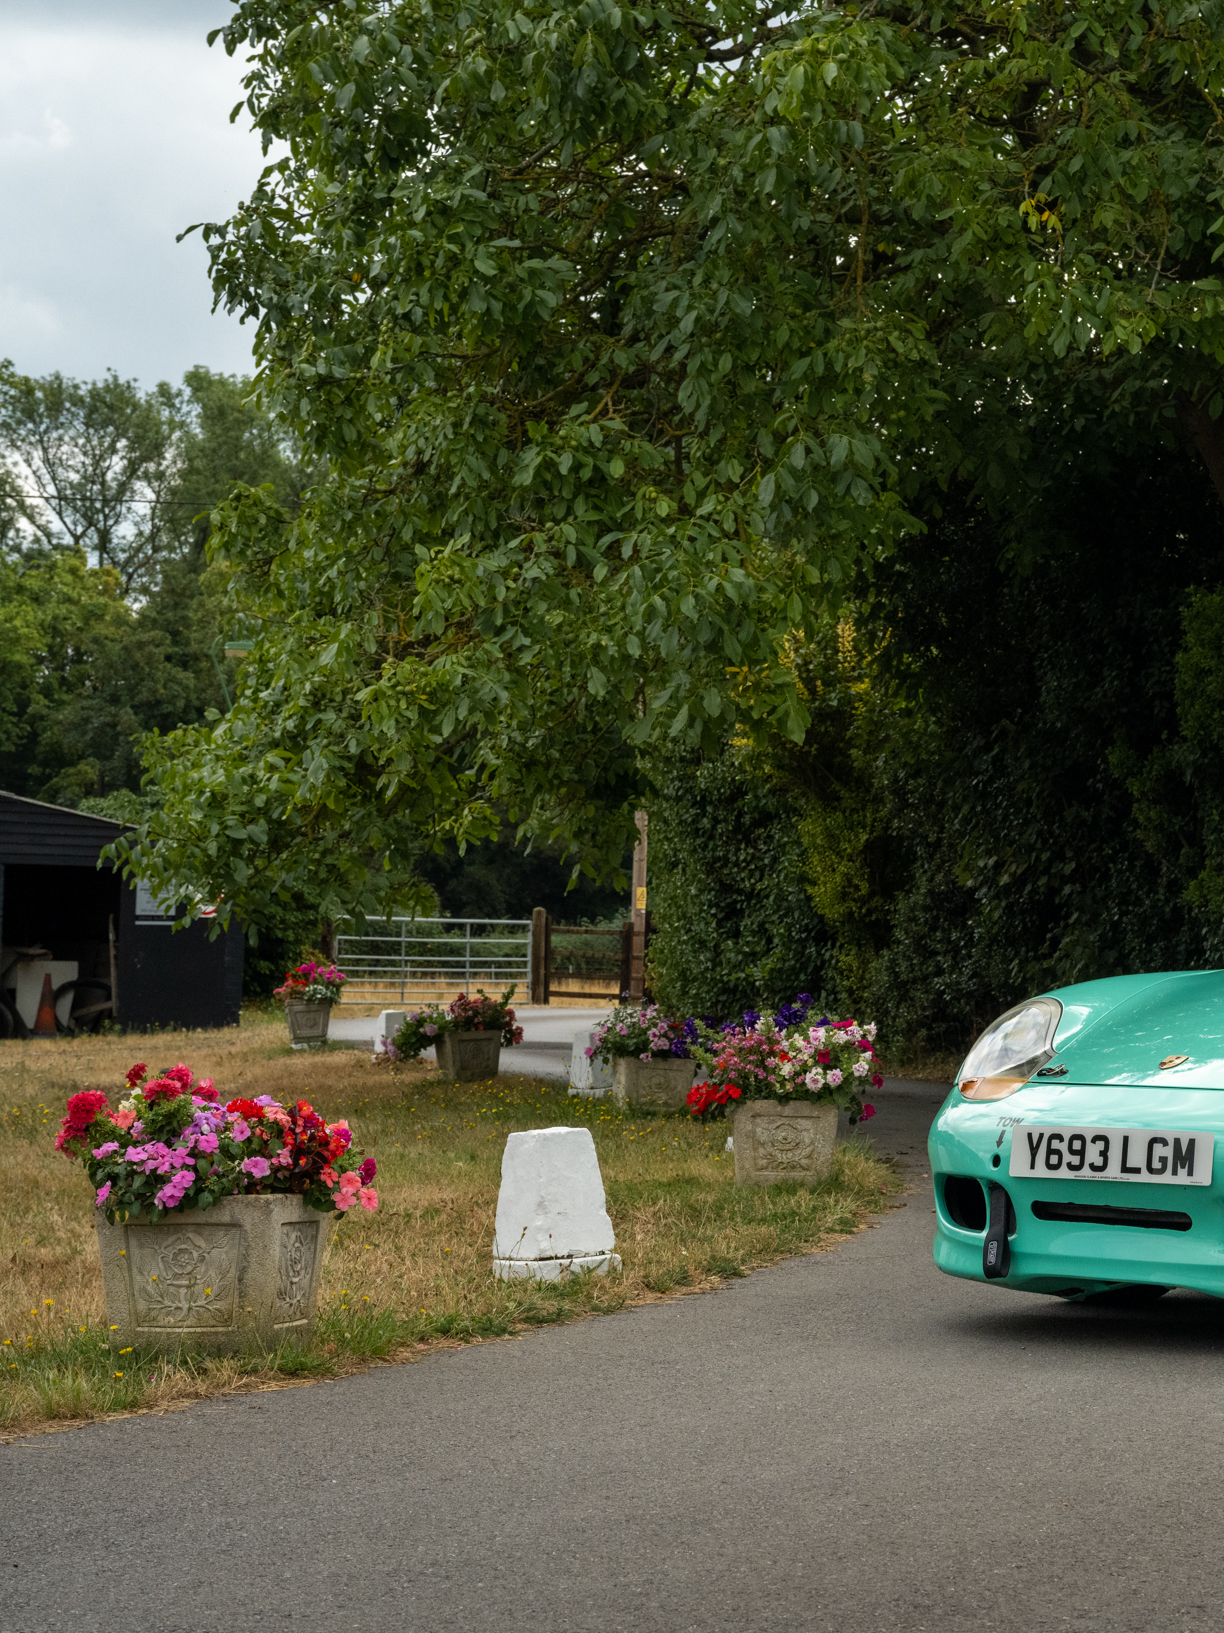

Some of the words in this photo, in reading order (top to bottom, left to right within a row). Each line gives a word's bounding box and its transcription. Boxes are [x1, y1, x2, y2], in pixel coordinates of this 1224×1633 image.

[996, 1116, 1025, 1127] TOW
[1027, 1132, 1110, 1172] Y693
[1120, 1135, 1196, 1177] LGM
